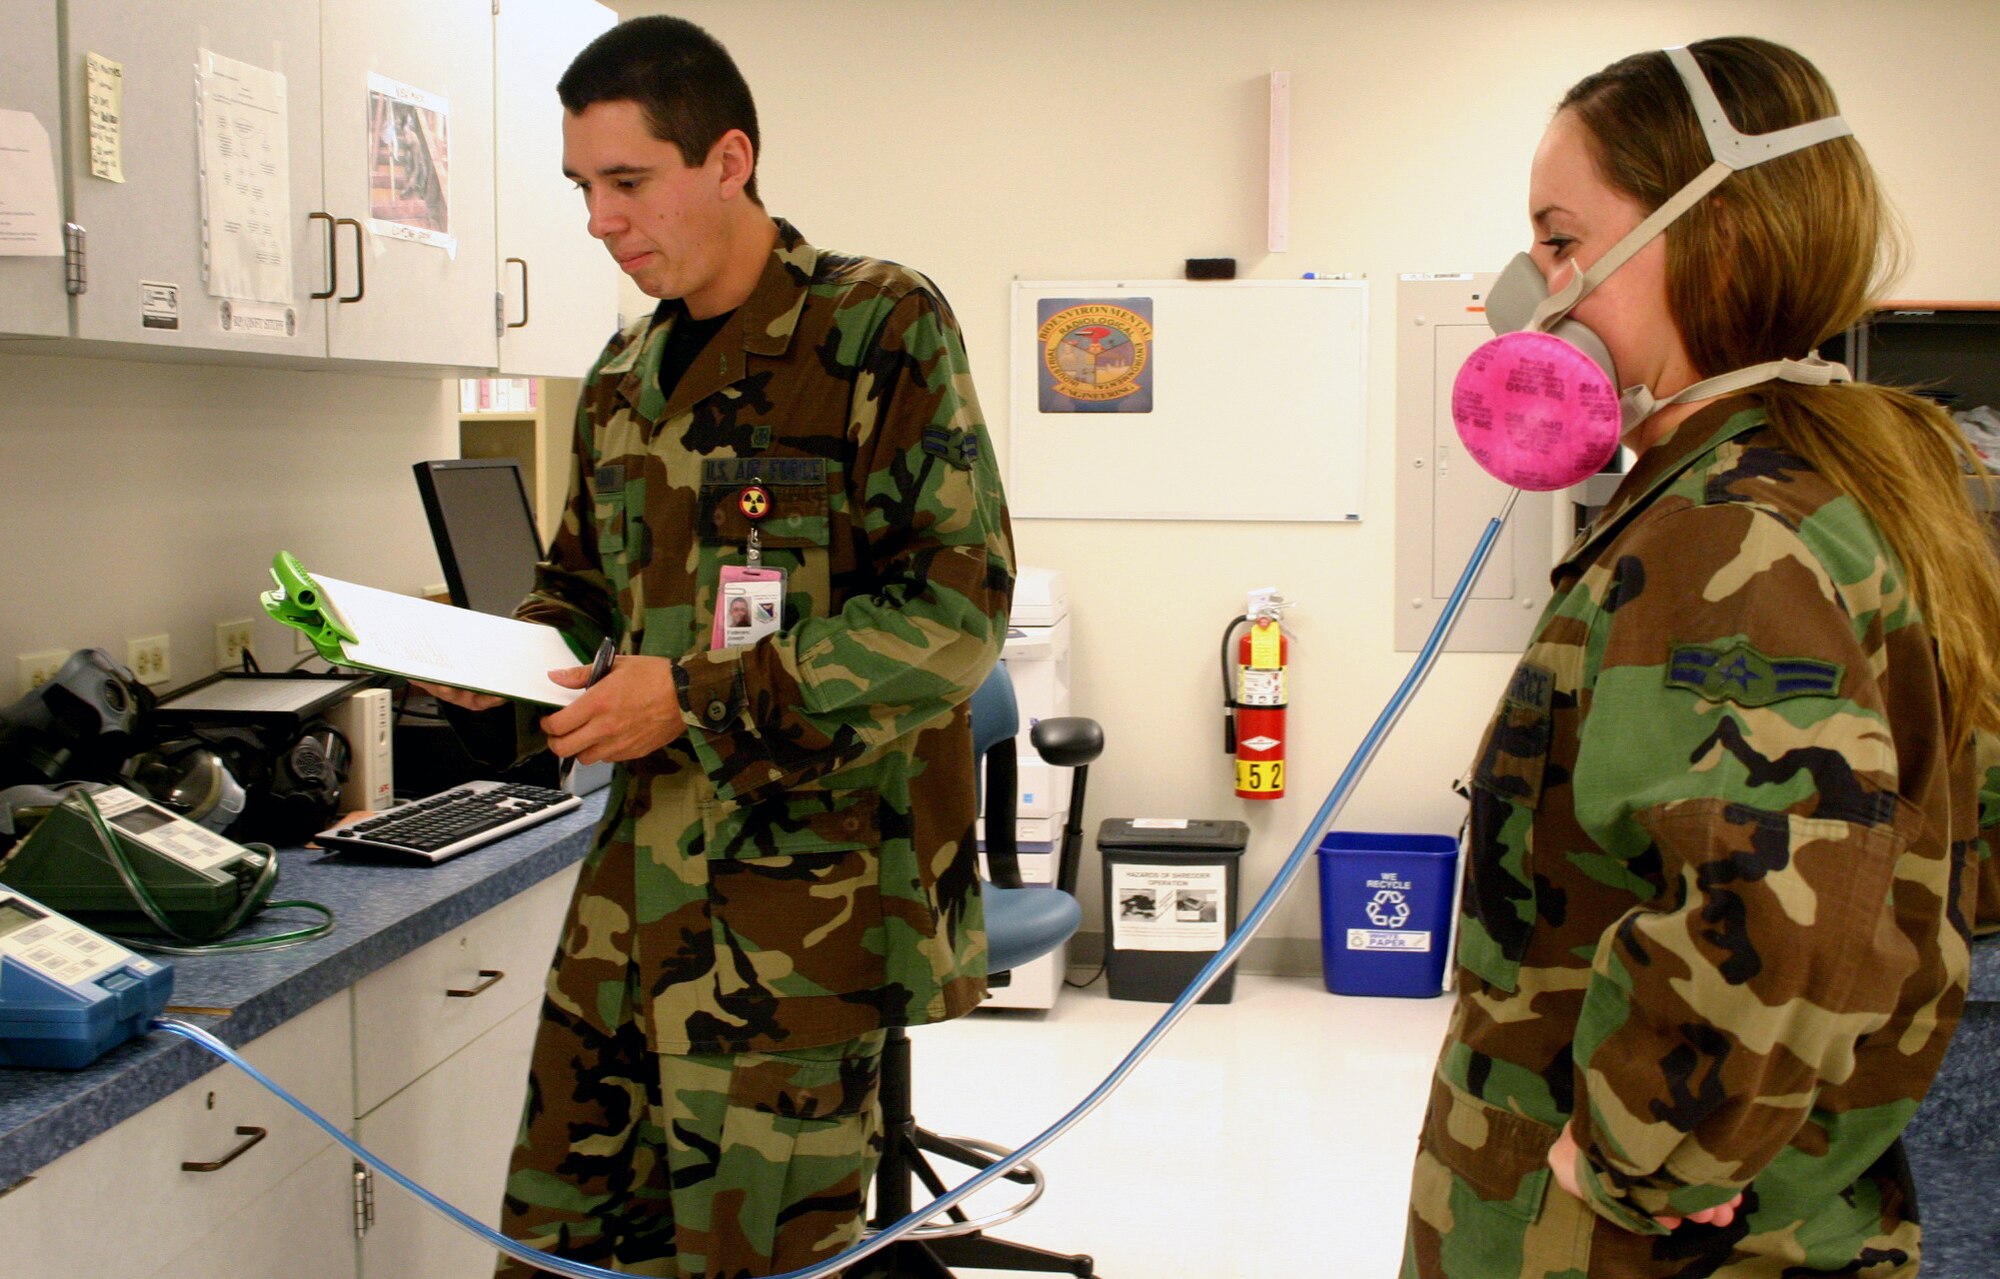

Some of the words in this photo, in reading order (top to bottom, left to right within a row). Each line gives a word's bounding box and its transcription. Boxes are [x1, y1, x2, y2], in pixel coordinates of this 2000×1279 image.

[1039, 306, 1151, 340] BIOENVIRONMENTAL
[1059, 317, 1134, 337] RADIOLOGICAL
[769, 460, 822, 481] FORCE
[1381, 872, 1398, 881] WE
[1366, 880, 1412, 890] RECYCLE
[1369, 938, 1406, 947] PAPER
